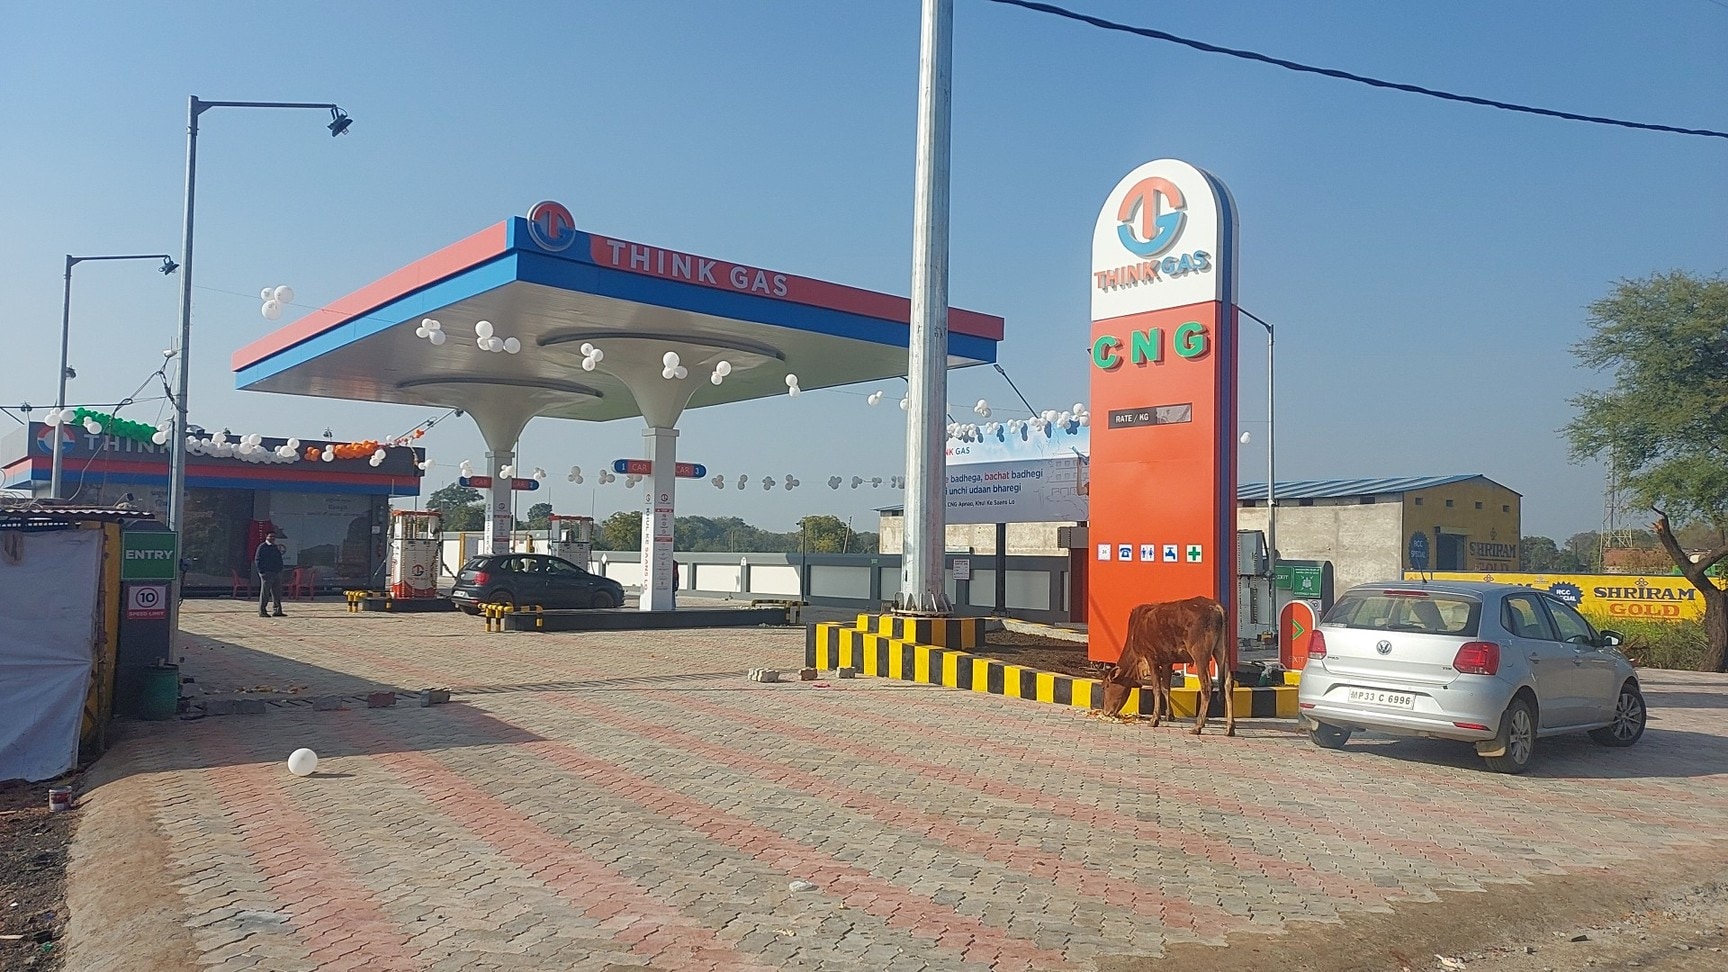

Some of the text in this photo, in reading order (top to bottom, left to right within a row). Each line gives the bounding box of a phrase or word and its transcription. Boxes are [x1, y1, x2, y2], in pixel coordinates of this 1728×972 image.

[606, 239, 788, 297] THINK GAS
[1094, 250, 1211, 290] THINK GAS
[1092, 321, 1209, 369] CNG
[1115, 414, 1133, 423] RATE
[1139, 413, 1149, 421] KG
[955, 447, 970, 455] GAS
[631, 463, 648, 472] CAR
[695, 467, 700, 475] 3
[950, 473, 983, 484] badhega,
[984, 470, 1010, 481] bachat
[1011, 468, 1043, 480] badhegi
[949, 486, 968, 496] unchi
[968, 484, 991, 494] udaan
[992, 482, 1022, 494] bharegi
[125, 549, 174, 560] ENTRY
[1469, 541, 1516, 558] SHRIRAM
[139, 592, 156, 603] 10
[1593, 586, 1697, 601] SHRIRAM
[1609, 603, 1681, 617] GOLD
[1350, 690, 1411, 705] MP33 C 6996
